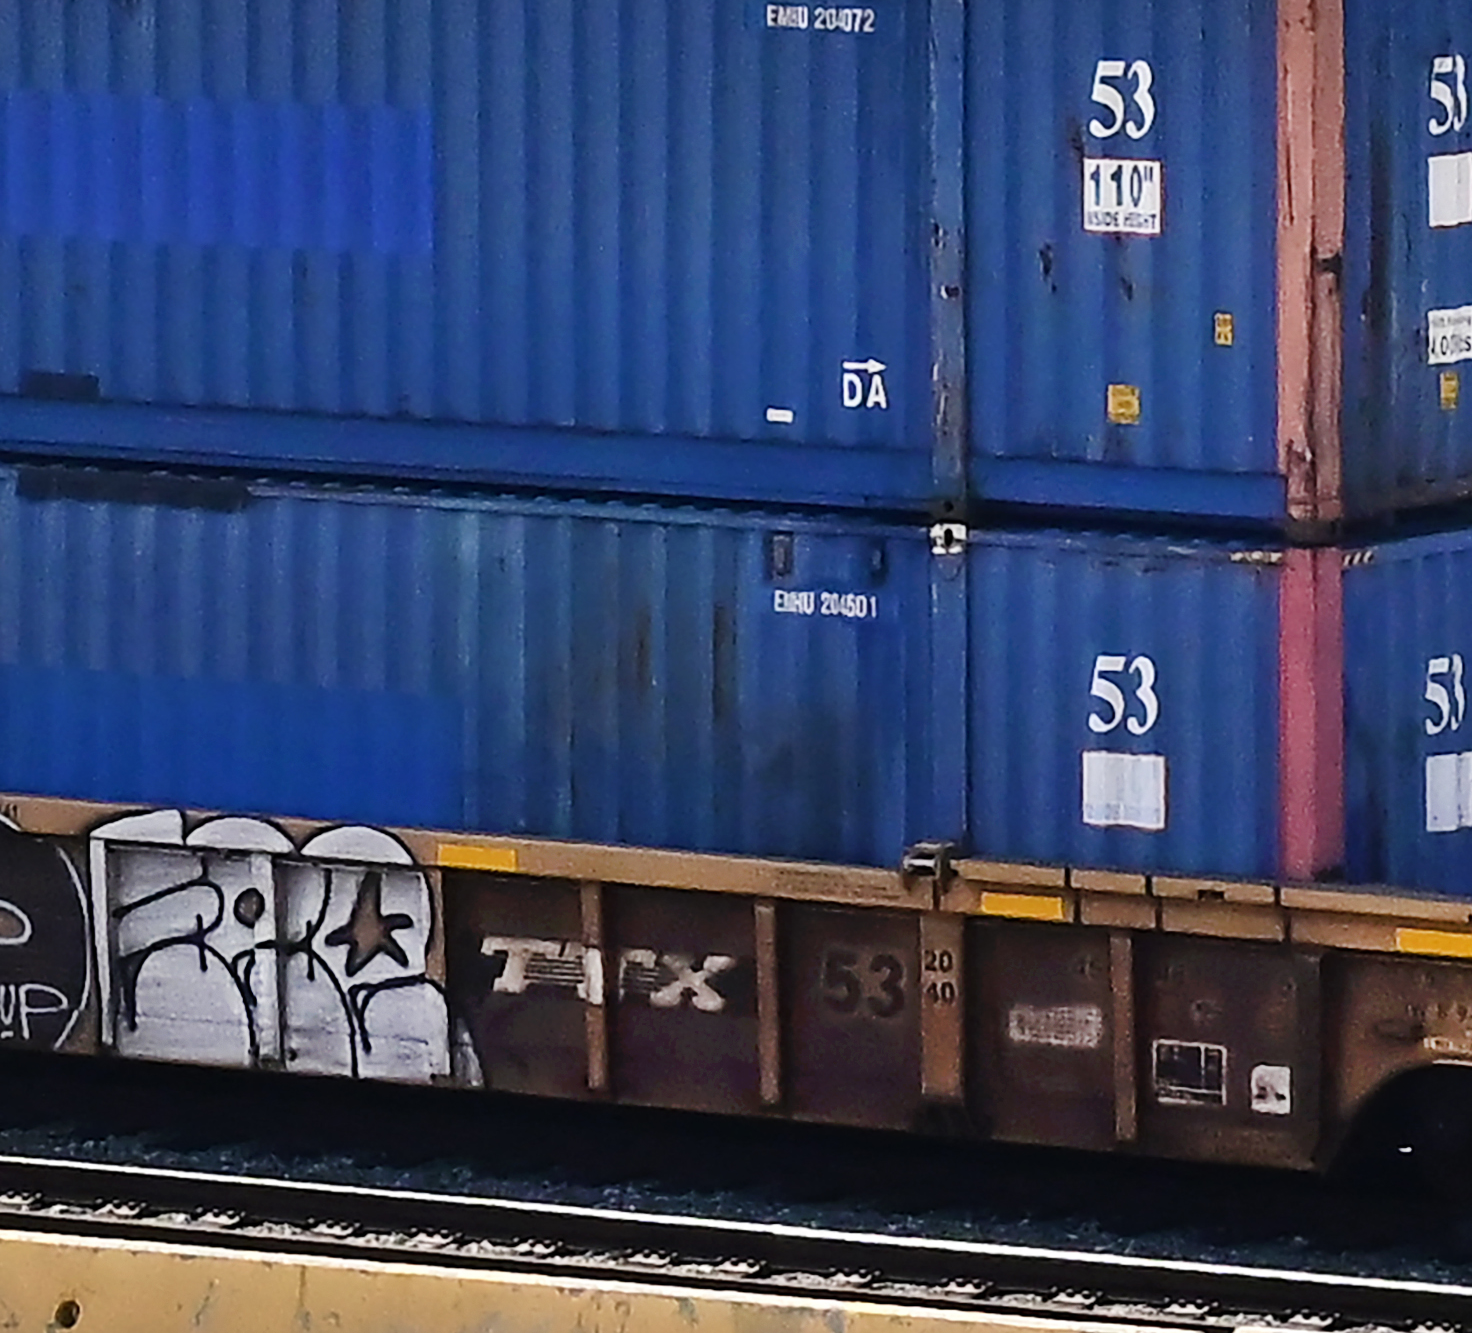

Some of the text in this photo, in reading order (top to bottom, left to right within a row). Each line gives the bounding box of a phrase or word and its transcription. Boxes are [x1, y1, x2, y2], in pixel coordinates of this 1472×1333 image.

[1088, 59, 1156, 140] 53
[1428, 54, 1467, 136] 53
[1087, 654, 1158, 737] 53
[1424, 654, 1465, 735] 53
[826, 947, 906, 1019] 53
[924, 949, 954, 973] 20
